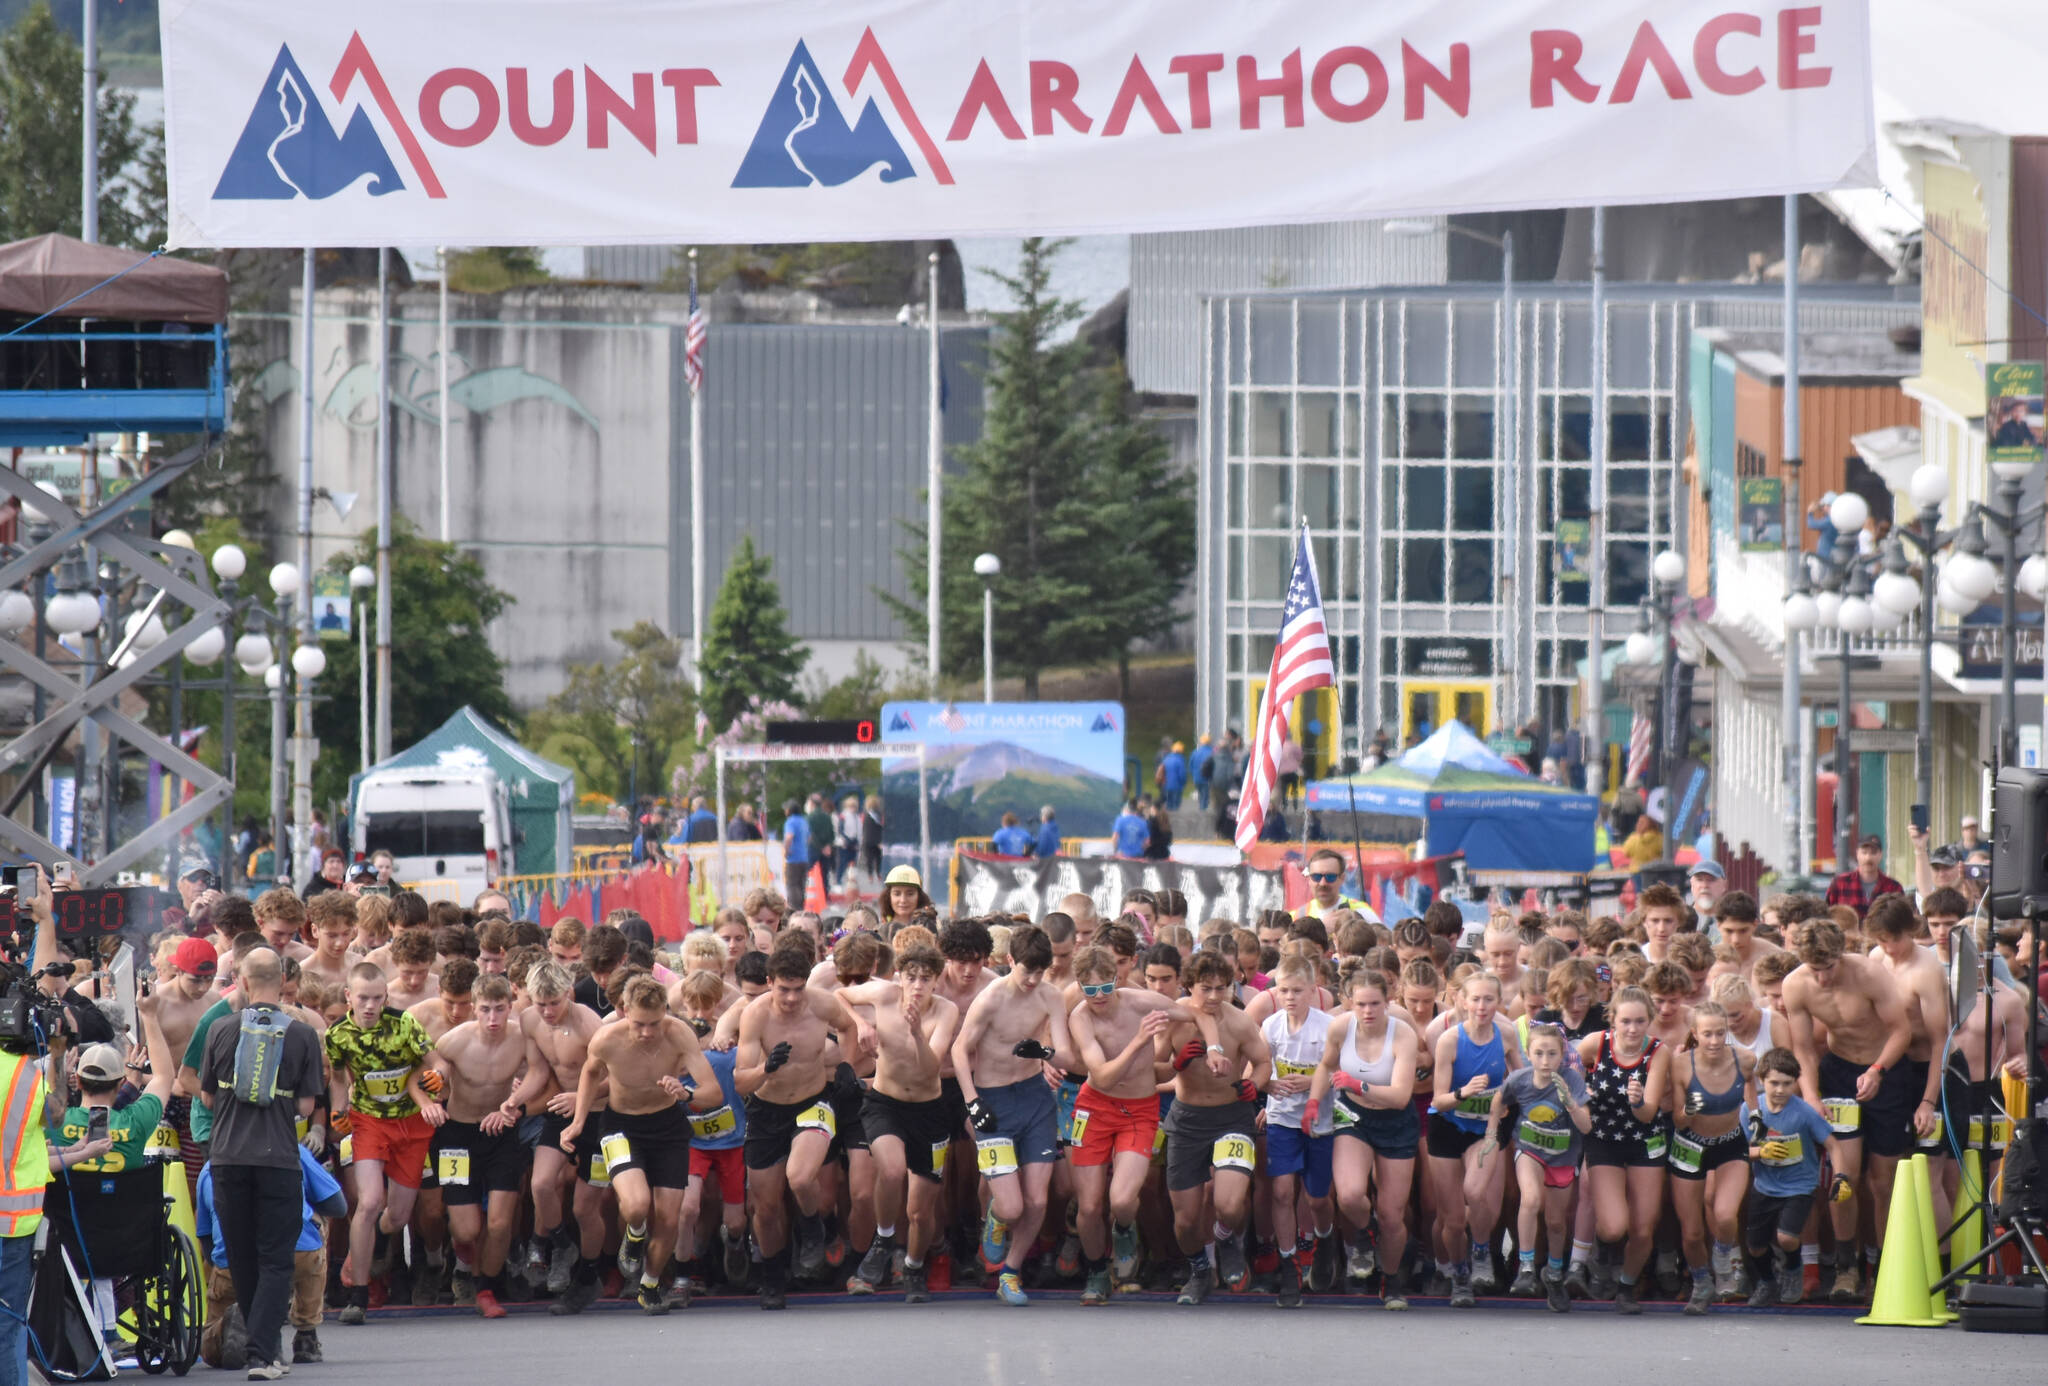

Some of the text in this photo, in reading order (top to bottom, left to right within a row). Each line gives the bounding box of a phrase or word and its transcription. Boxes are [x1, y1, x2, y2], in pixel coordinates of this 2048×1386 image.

[1530, 8, 1833, 108] RACE
[929, 713, 1083, 730] MNT MARATHON
[857, 721, 874, 743] 0
[249, 1041, 266, 1102] NATHAN
[384, 1080, 399, 1095] 23
[818, 1109, 825, 1122] 8
[1470, 1099, 1490, 1115] 210
[704, 1119, 720, 1134] 65
[156, 1129, 171, 1147] 92
[1534, 1131, 1555, 1149] 310
[1686, 1130, 1716, 1146] NIKE
[1718, 1125, 1740, 1144] PRO
[990, 1149, 997, 1166] 9
[1228, 1142, 1243, 1158] 28
[450, 1159, 458, 1177] 3
